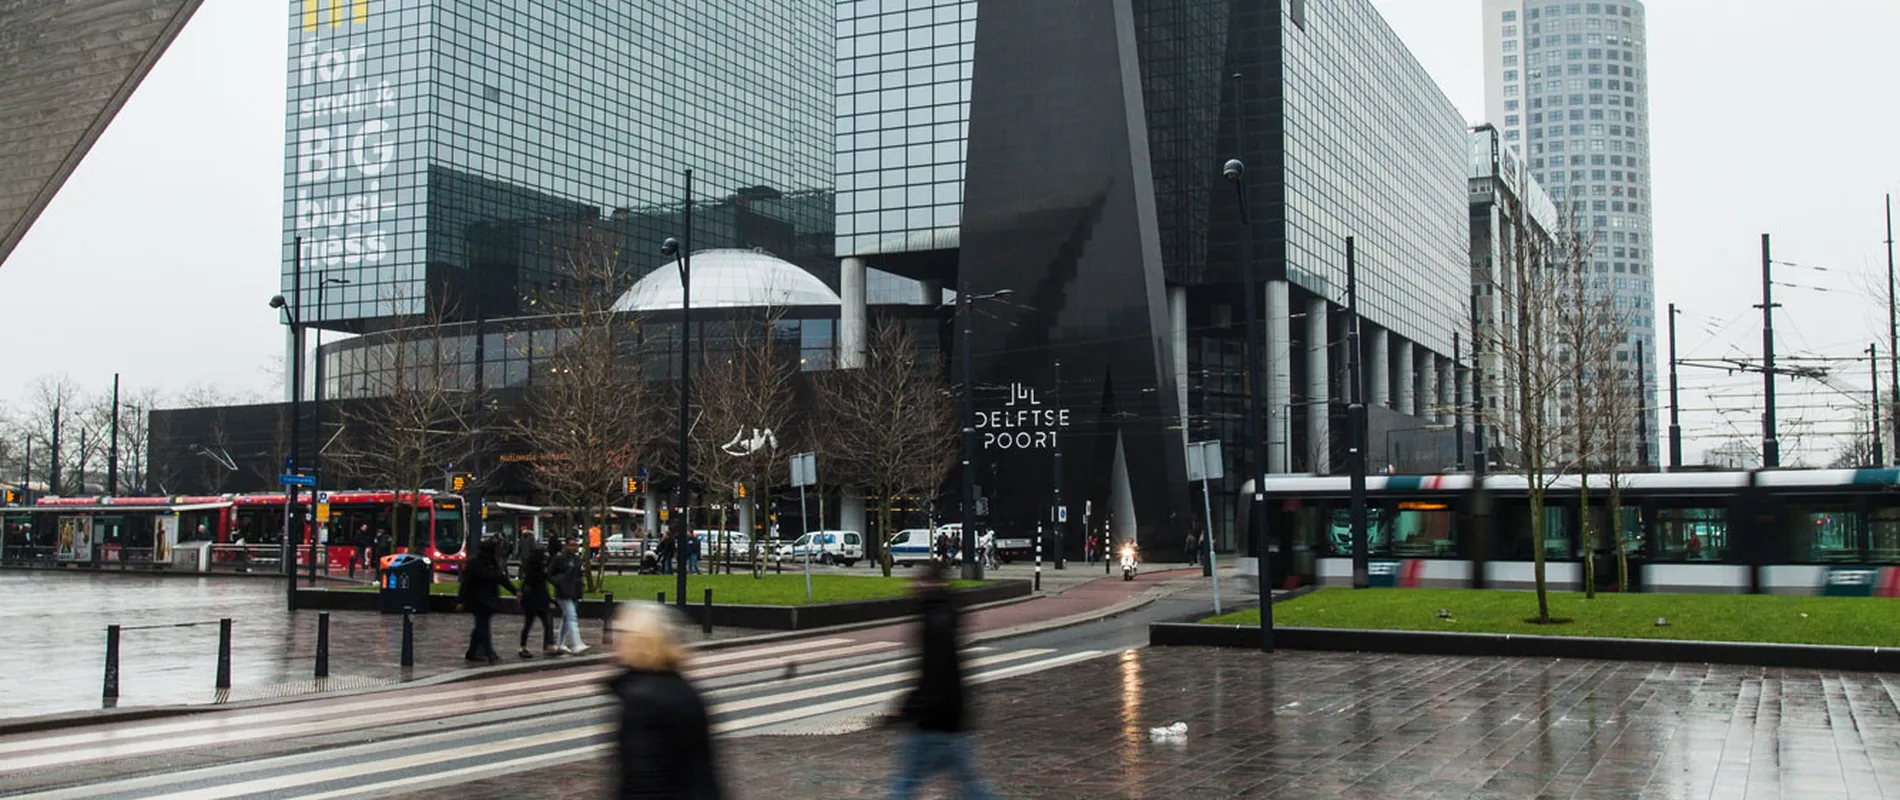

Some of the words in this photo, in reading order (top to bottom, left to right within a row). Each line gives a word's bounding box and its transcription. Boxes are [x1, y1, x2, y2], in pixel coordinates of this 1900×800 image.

[301, 37, 367, 84] for
[300, 83, 369, 118] small
[376, 79, 396, 108] &
[298, 119, 394, 182] BIG
[296, 181, 397, 230] busi-
[299, 231, 387, 267] ness
[974, 409, 1070, 428] DELFTSE
[984, 431, 1058, 449] POORT
